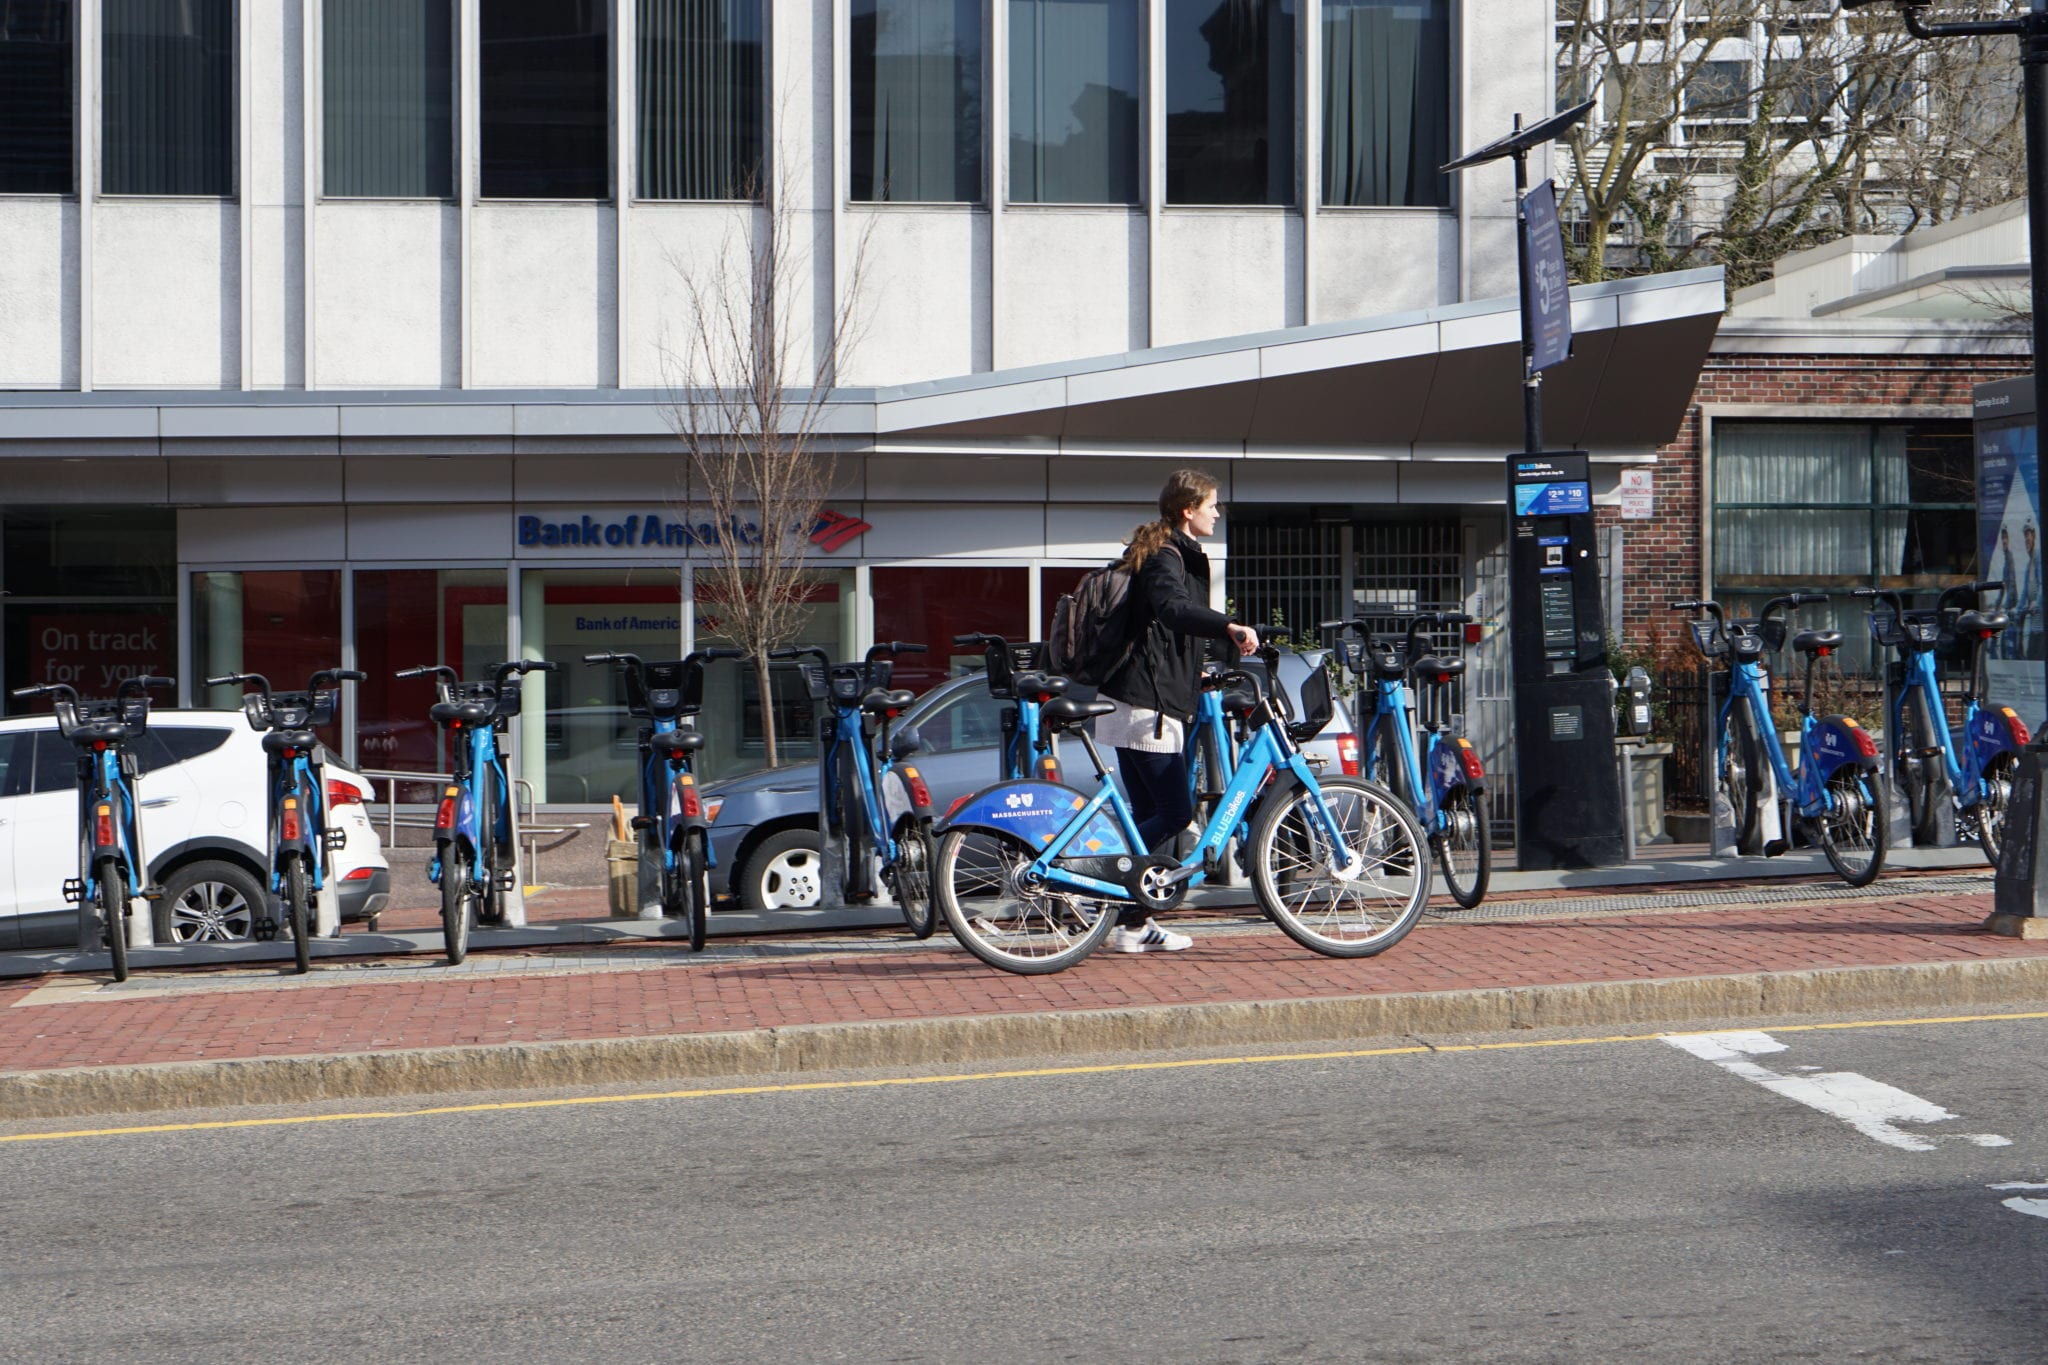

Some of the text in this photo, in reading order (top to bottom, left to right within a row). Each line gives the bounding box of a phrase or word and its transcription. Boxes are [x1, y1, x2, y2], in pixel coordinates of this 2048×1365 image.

[1631, 476, 1642, 486] NO
[518, 515, 777, 546] Bank of Americ
[575, 617, 682, 631] Bank of Americ
[41, 626, 158, 651] On track
[45, 658, 158, 689] for your
[992, 809, 1053, 819] MASSACHUSETTS
[1210, 790, 1247, 846] BLUEbikes
